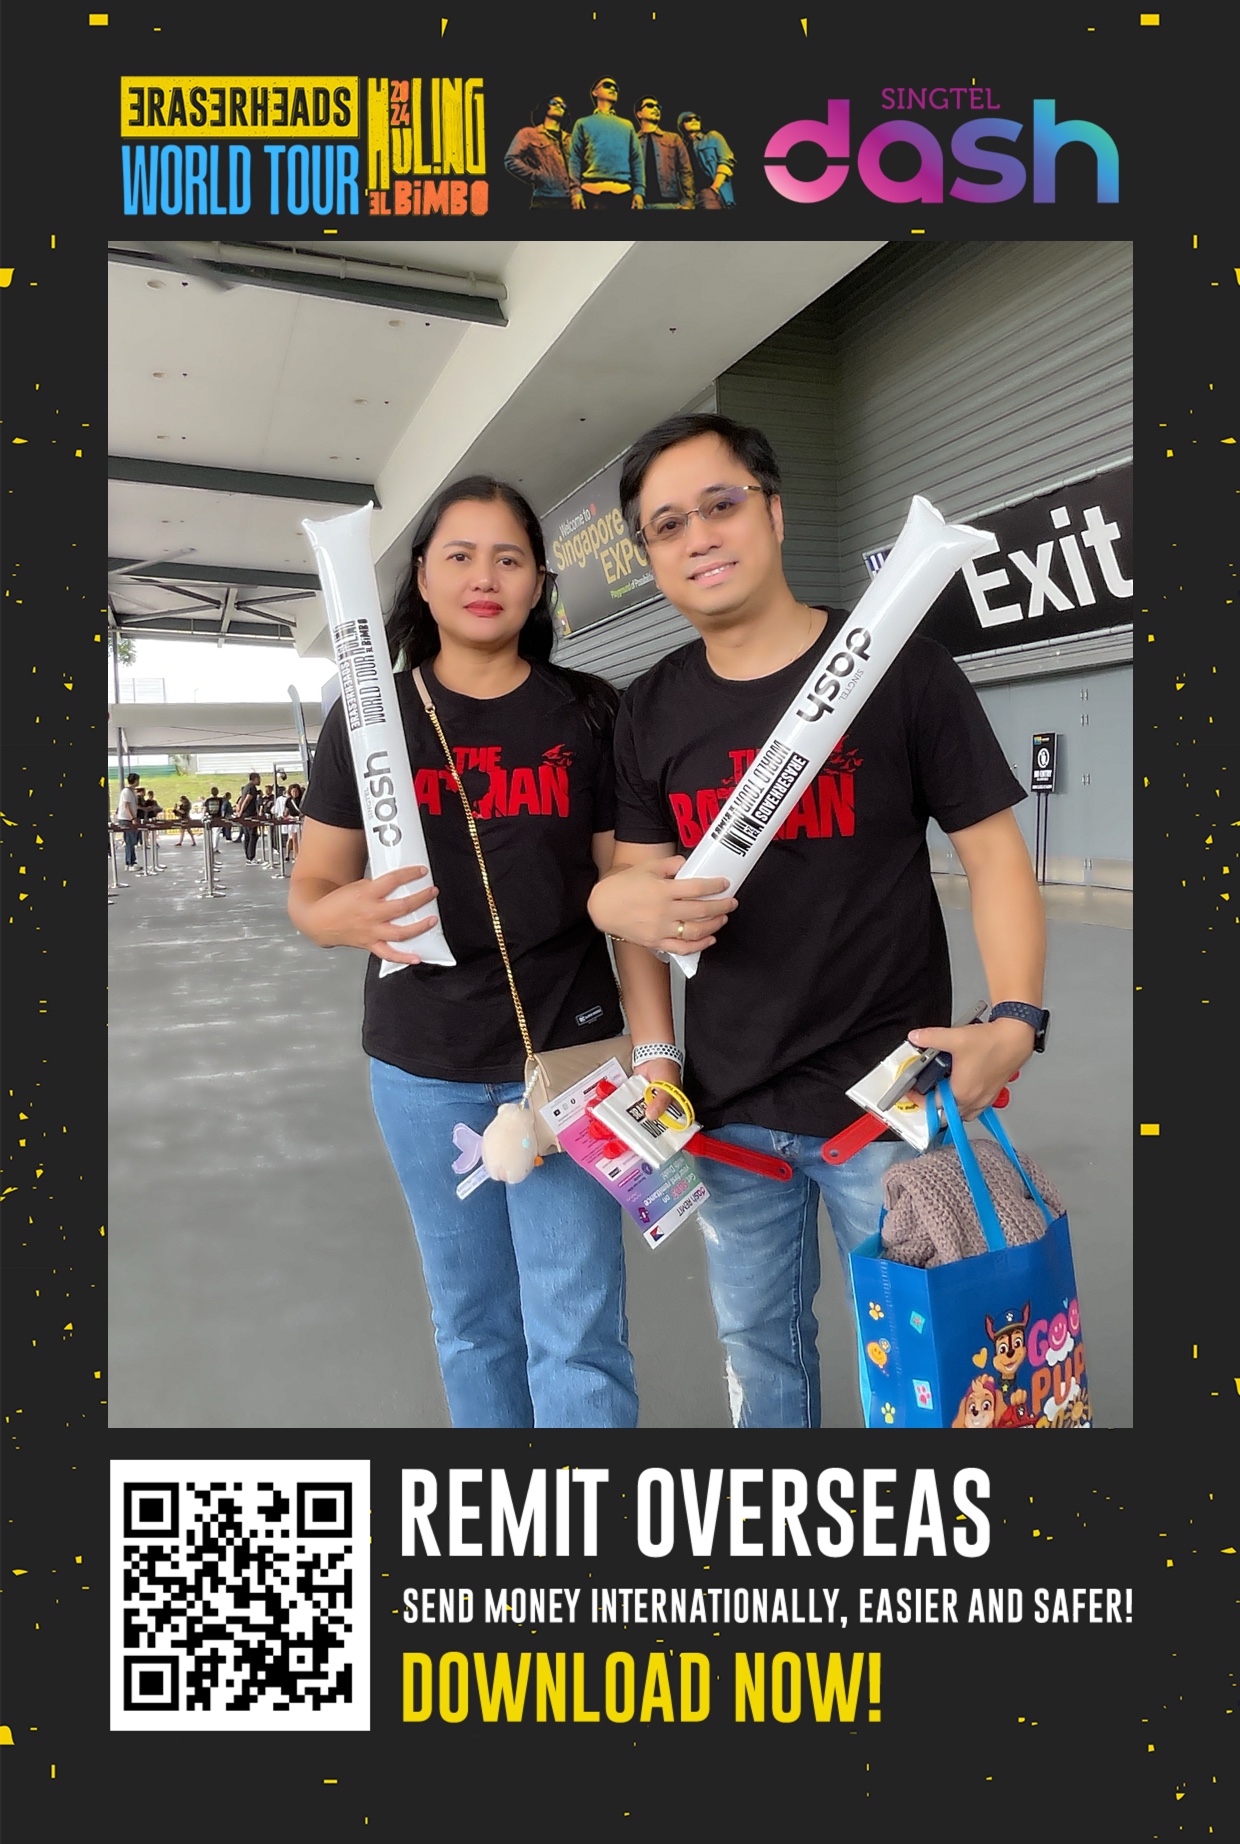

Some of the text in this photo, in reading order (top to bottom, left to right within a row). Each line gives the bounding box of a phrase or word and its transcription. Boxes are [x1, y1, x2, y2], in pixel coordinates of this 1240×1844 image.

[552, 507, 625, 571] Singapore
[559, 508, 592, 538] Welcome to
[961, 505, 1134, 629] Exit
[353, 655, 387, 726] WORLD TOUR
[796, 627, 872, 722] dash
[838, 668, 864, 700] SINGTEL
[453, 746, 502, 774] THE
[733, 739, 792, 813] WORLD TOUR
[363, 750, 403, 848] dash
[643, 1180, 671, 1206] remittance
[685, 1172, 696, 1183] Get
[661, 1194, 671, 1204] on
[676, 1186, 706, 1217] dash REMIT
